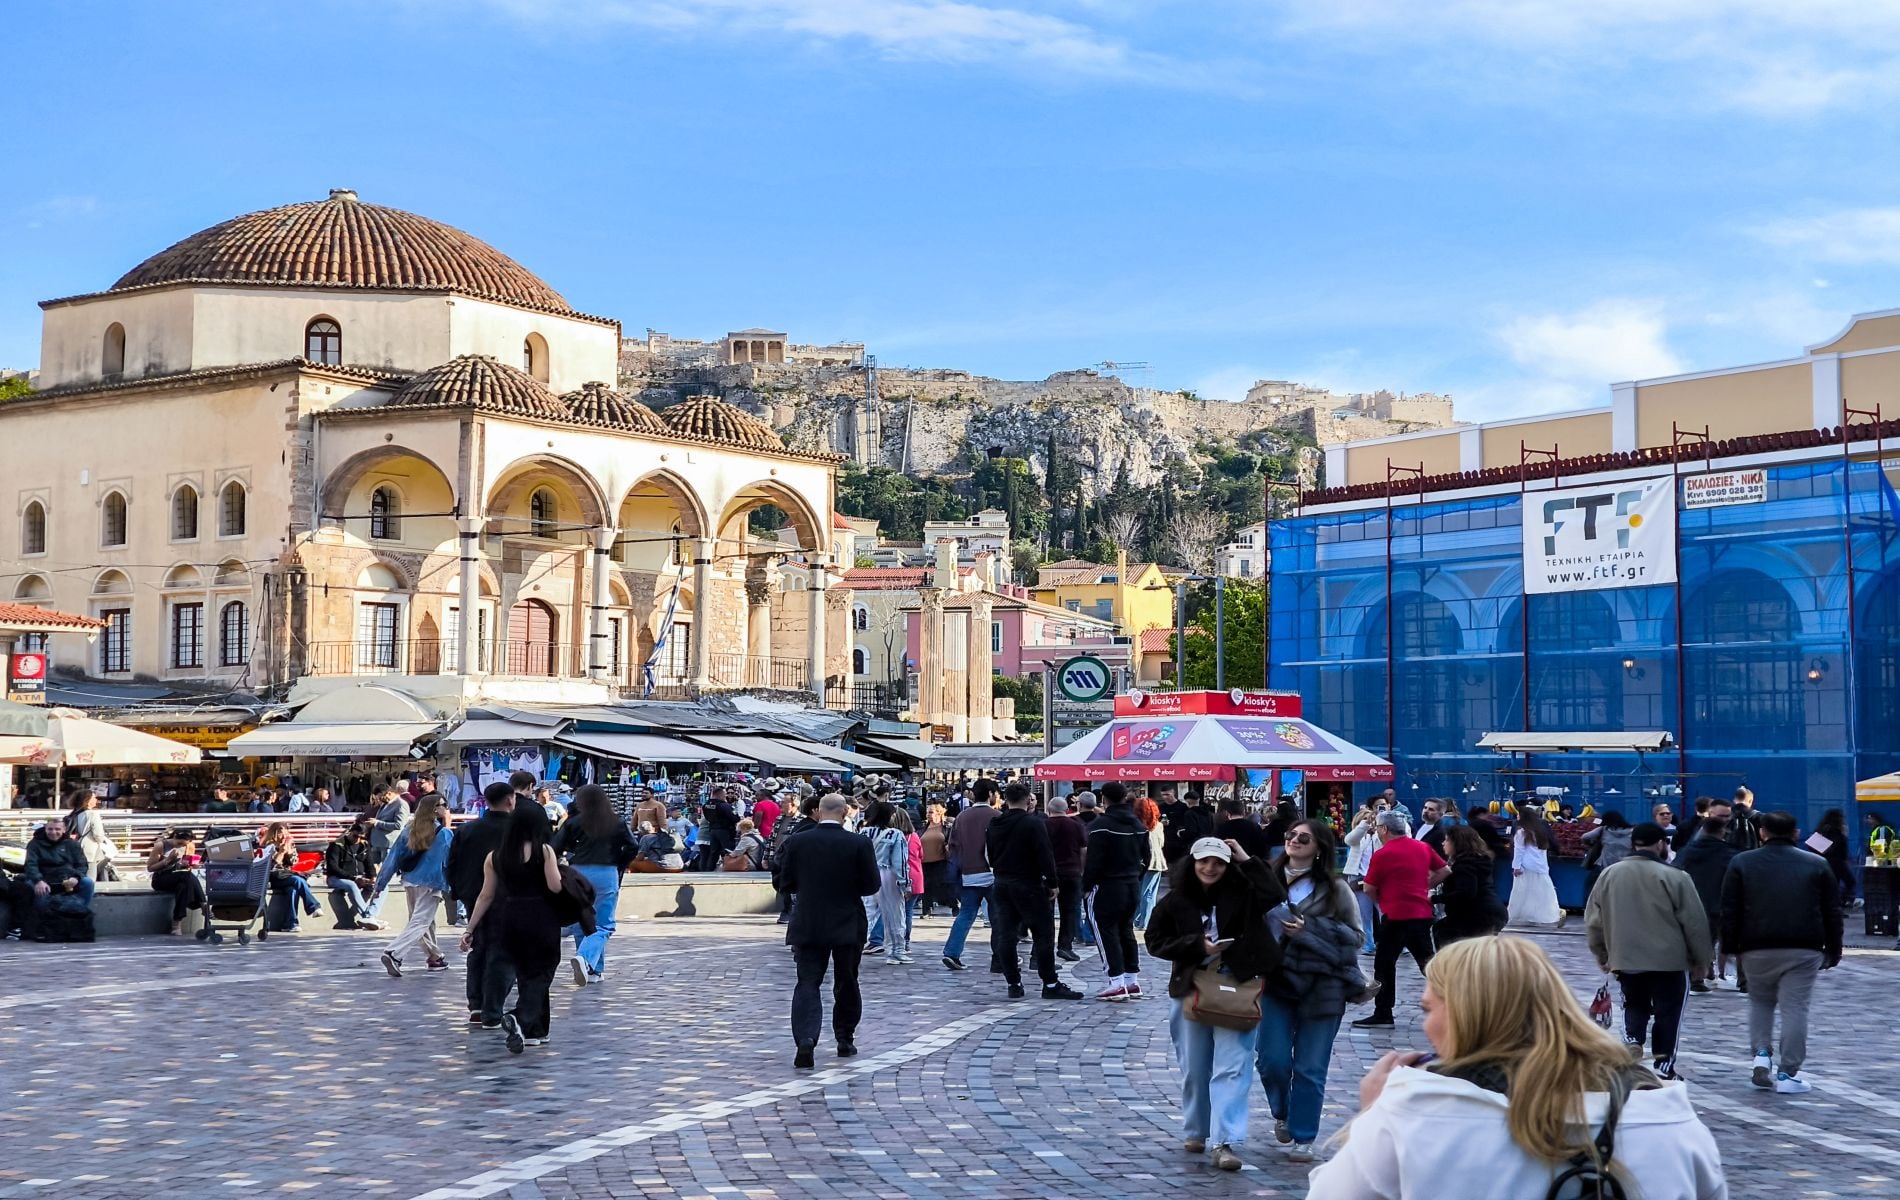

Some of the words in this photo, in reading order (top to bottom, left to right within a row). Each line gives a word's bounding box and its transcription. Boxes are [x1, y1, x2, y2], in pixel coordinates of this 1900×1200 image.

[1687, 475, 1735, 491] ΣΚΑΛΩΣΙΕΣ
[1741, 472, 1764, 485] ΝΙΚΑ
[1546, 556, 1592, 567] ΤΕΧΝΙΚΗ
[1599, 551, 1645, 562] ΕΤΑΙΡΙΑ
[1547, 564, 1646, 584] www.ftf.gr
[1150, 695, 1181, 705] kiosky's
[1244, 696, 1276, 706] kiosky's
